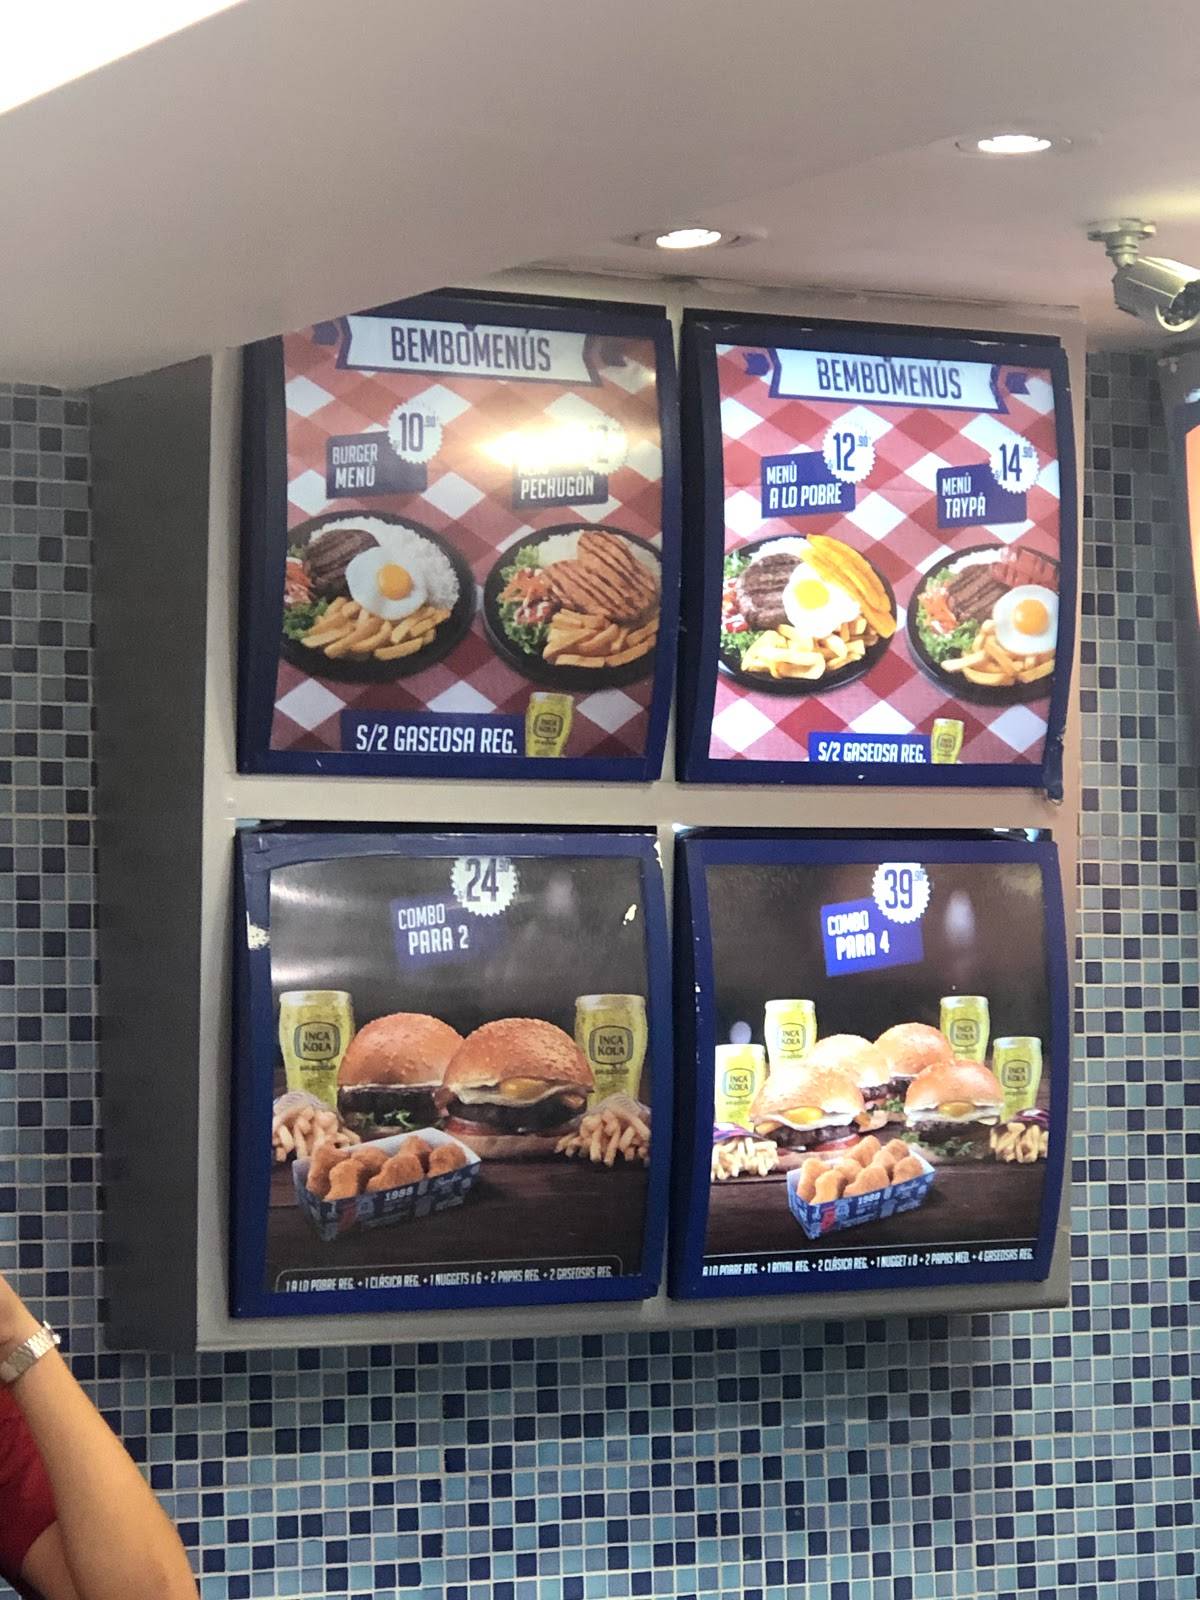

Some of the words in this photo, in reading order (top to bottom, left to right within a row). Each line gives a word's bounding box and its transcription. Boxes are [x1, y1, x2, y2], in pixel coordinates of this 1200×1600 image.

[391, 326, 551, 371] BEMBOMENÚS
[816, 358, 962, 399] BEMBOMENÚS
[332, 443, 378, 465] BURGER
[335, 461, 376, 489] MENÚ
[766, 460, 797, 485] MENÚ
[942, 472, 972, 496] MENÚ
[520, 472, 594, 500] PECHUGÓN
[769, 487, 779, 509] A
[782, 486, 797, 508] LO
[801, 483, 842, 507] POBRE
[945, 491, 986, 519] TAYPÁ
[356, 723, 388, 752] S/2
[394, 725, 473, 753] GASEOSA
[480, 728, 518, 754] REG.
[818, 741, 840, 762] S/2
[843, 742, 898, 763] GASEOSA
[901, 744, 927, 763] REG.
[399, 903, 446, 930] COMBO
[827, 910, 869, 936] COMBO
[408, 928, 452, 956] PARA
[458, 925, 469, 949] 2
[836, 932, 876, 961] PARA
[880, 930, 890, 954] 4
[303, 1042, 332, 1052] KOLA
[304, 1031, 331, 1041] INCA
[599, 1035, 624, 1045] INCA
[597, 1046, 625, 1056] KOLA
[931, 1252, 954, 1265] PAPAS
[310, 1278, 337, 1291] POBRE
[435, 1271, 469, 1287] NUGGETS
[490, 1271, 496, 1283] 2
[498, 1269, 523, 1283] PAPAS
[549, 1267, 556, 1280] 2
[556, 1266, 596, 1280] GASEOSAS
